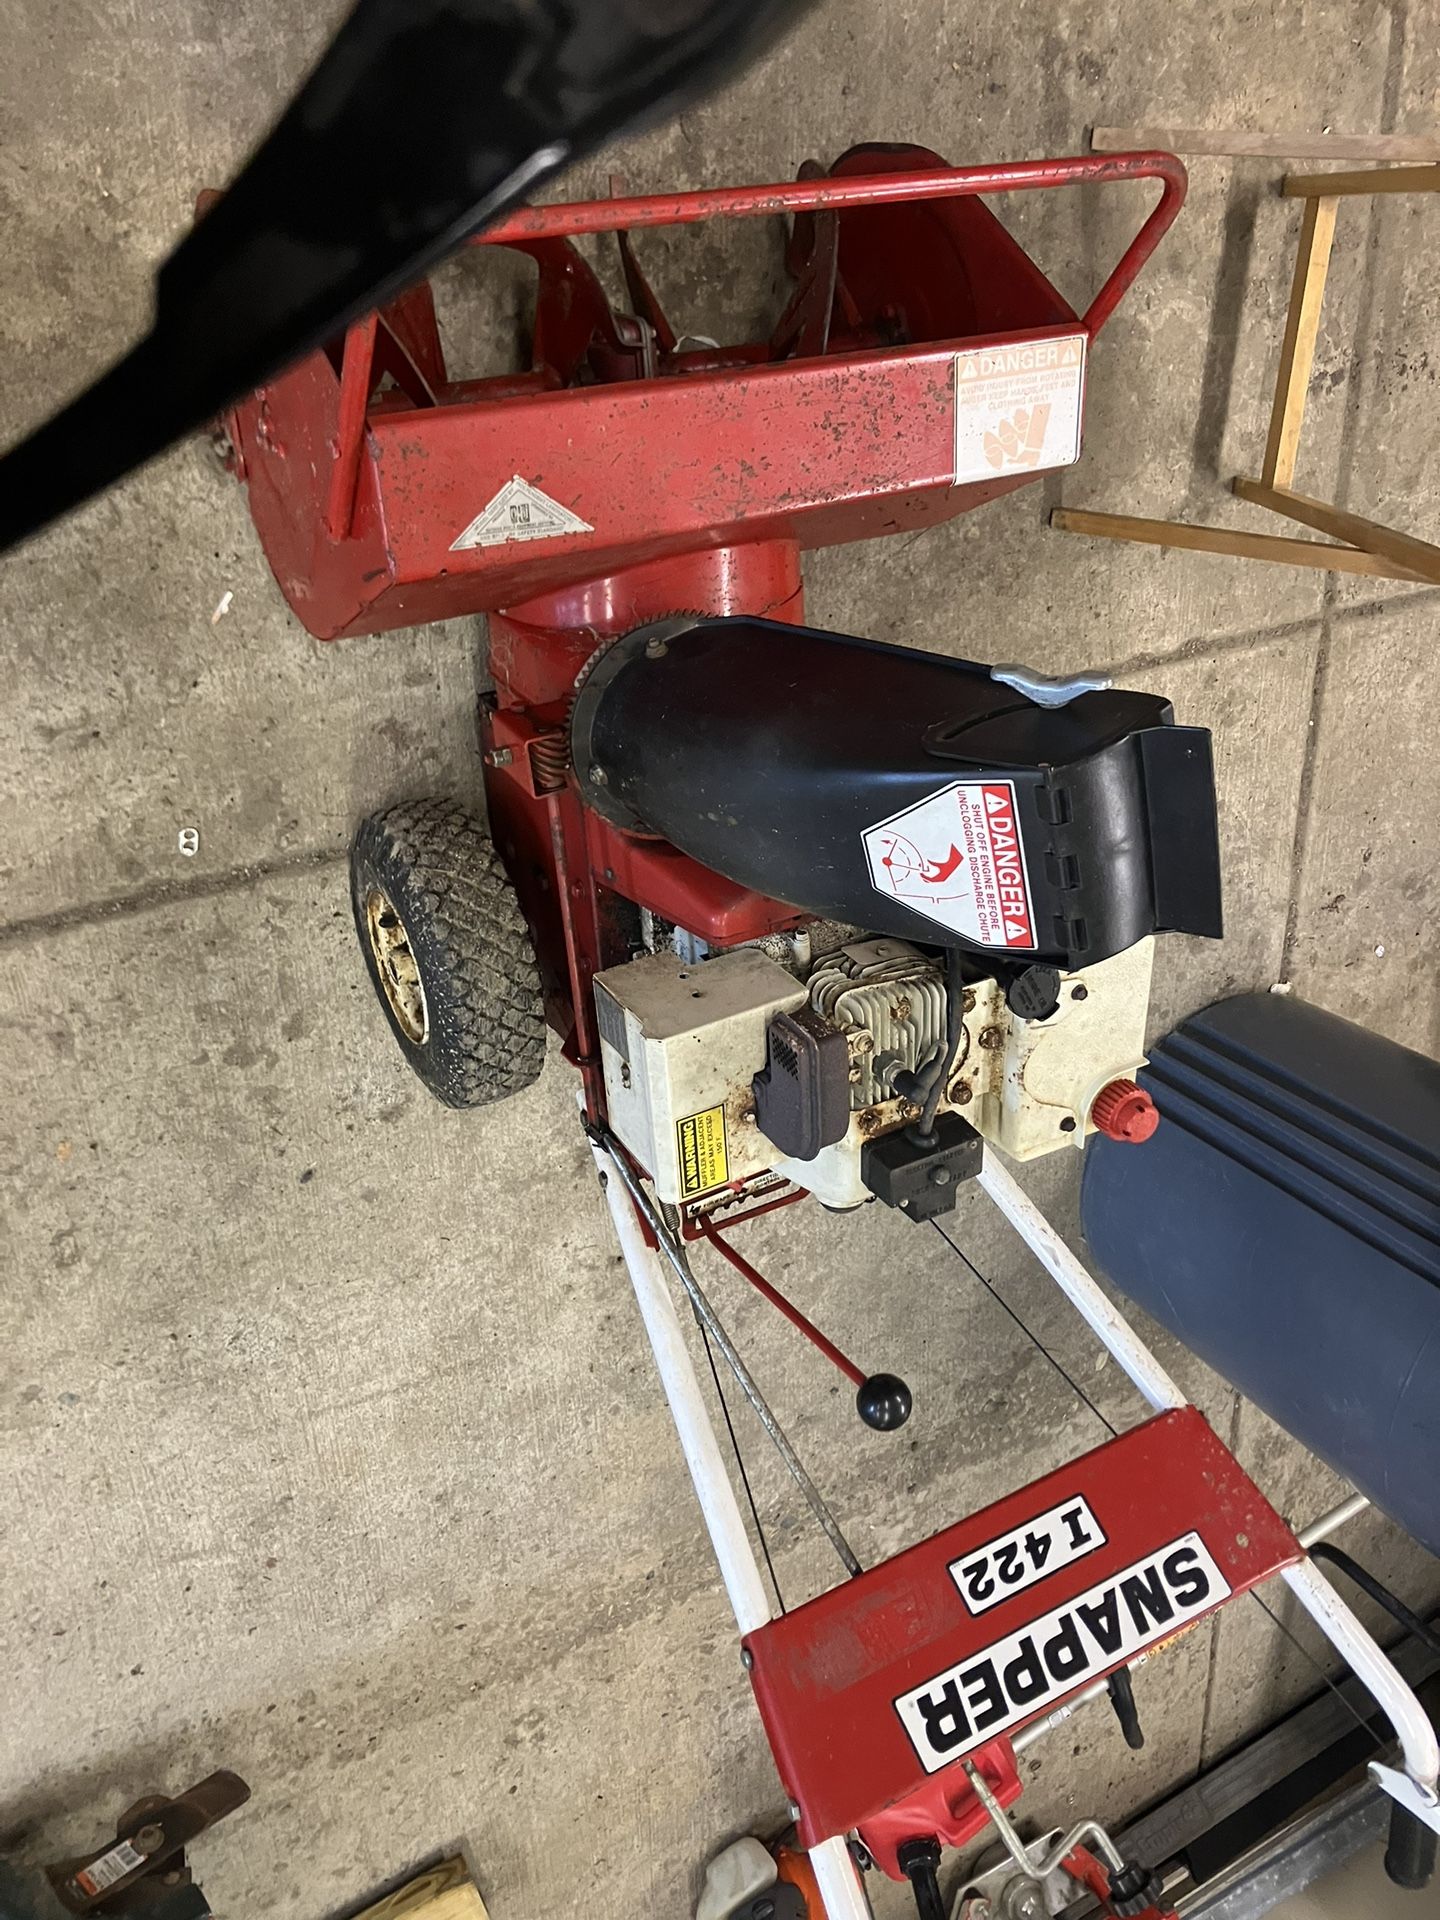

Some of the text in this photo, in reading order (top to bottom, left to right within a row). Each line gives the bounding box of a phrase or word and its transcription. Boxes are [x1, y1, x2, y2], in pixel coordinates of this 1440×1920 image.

[960, 370, 1077, 395] AVOID INJURY FROM ROTATING
[981, 348, 1057, 375] DANGER
[988, 390, 1009, 401] KEEP
[1061, 379, 1077, 390] AND
[988, 394, 1051, 411] CLOTHING AWAY
[957, 790, 991, 943] UNCLOGGING DISCHARGE CHUTE
[971, 803, 1001, 930] SHUT OFF ENGINE BEFORE
[988, 817, 1025, 917] DANGER
[683, 1121, 698, 1180] WARNING
[697, 1115, 706, 1150] ADJACENT
[705, 1115, 717, 1181] AREAS MAY EXCEED
[699, 1157, 709, 1188] MUFFLER
[961, 1505, 1092, 1602] I 422
[916, 1547, 1210, 1755] SNAPPER
